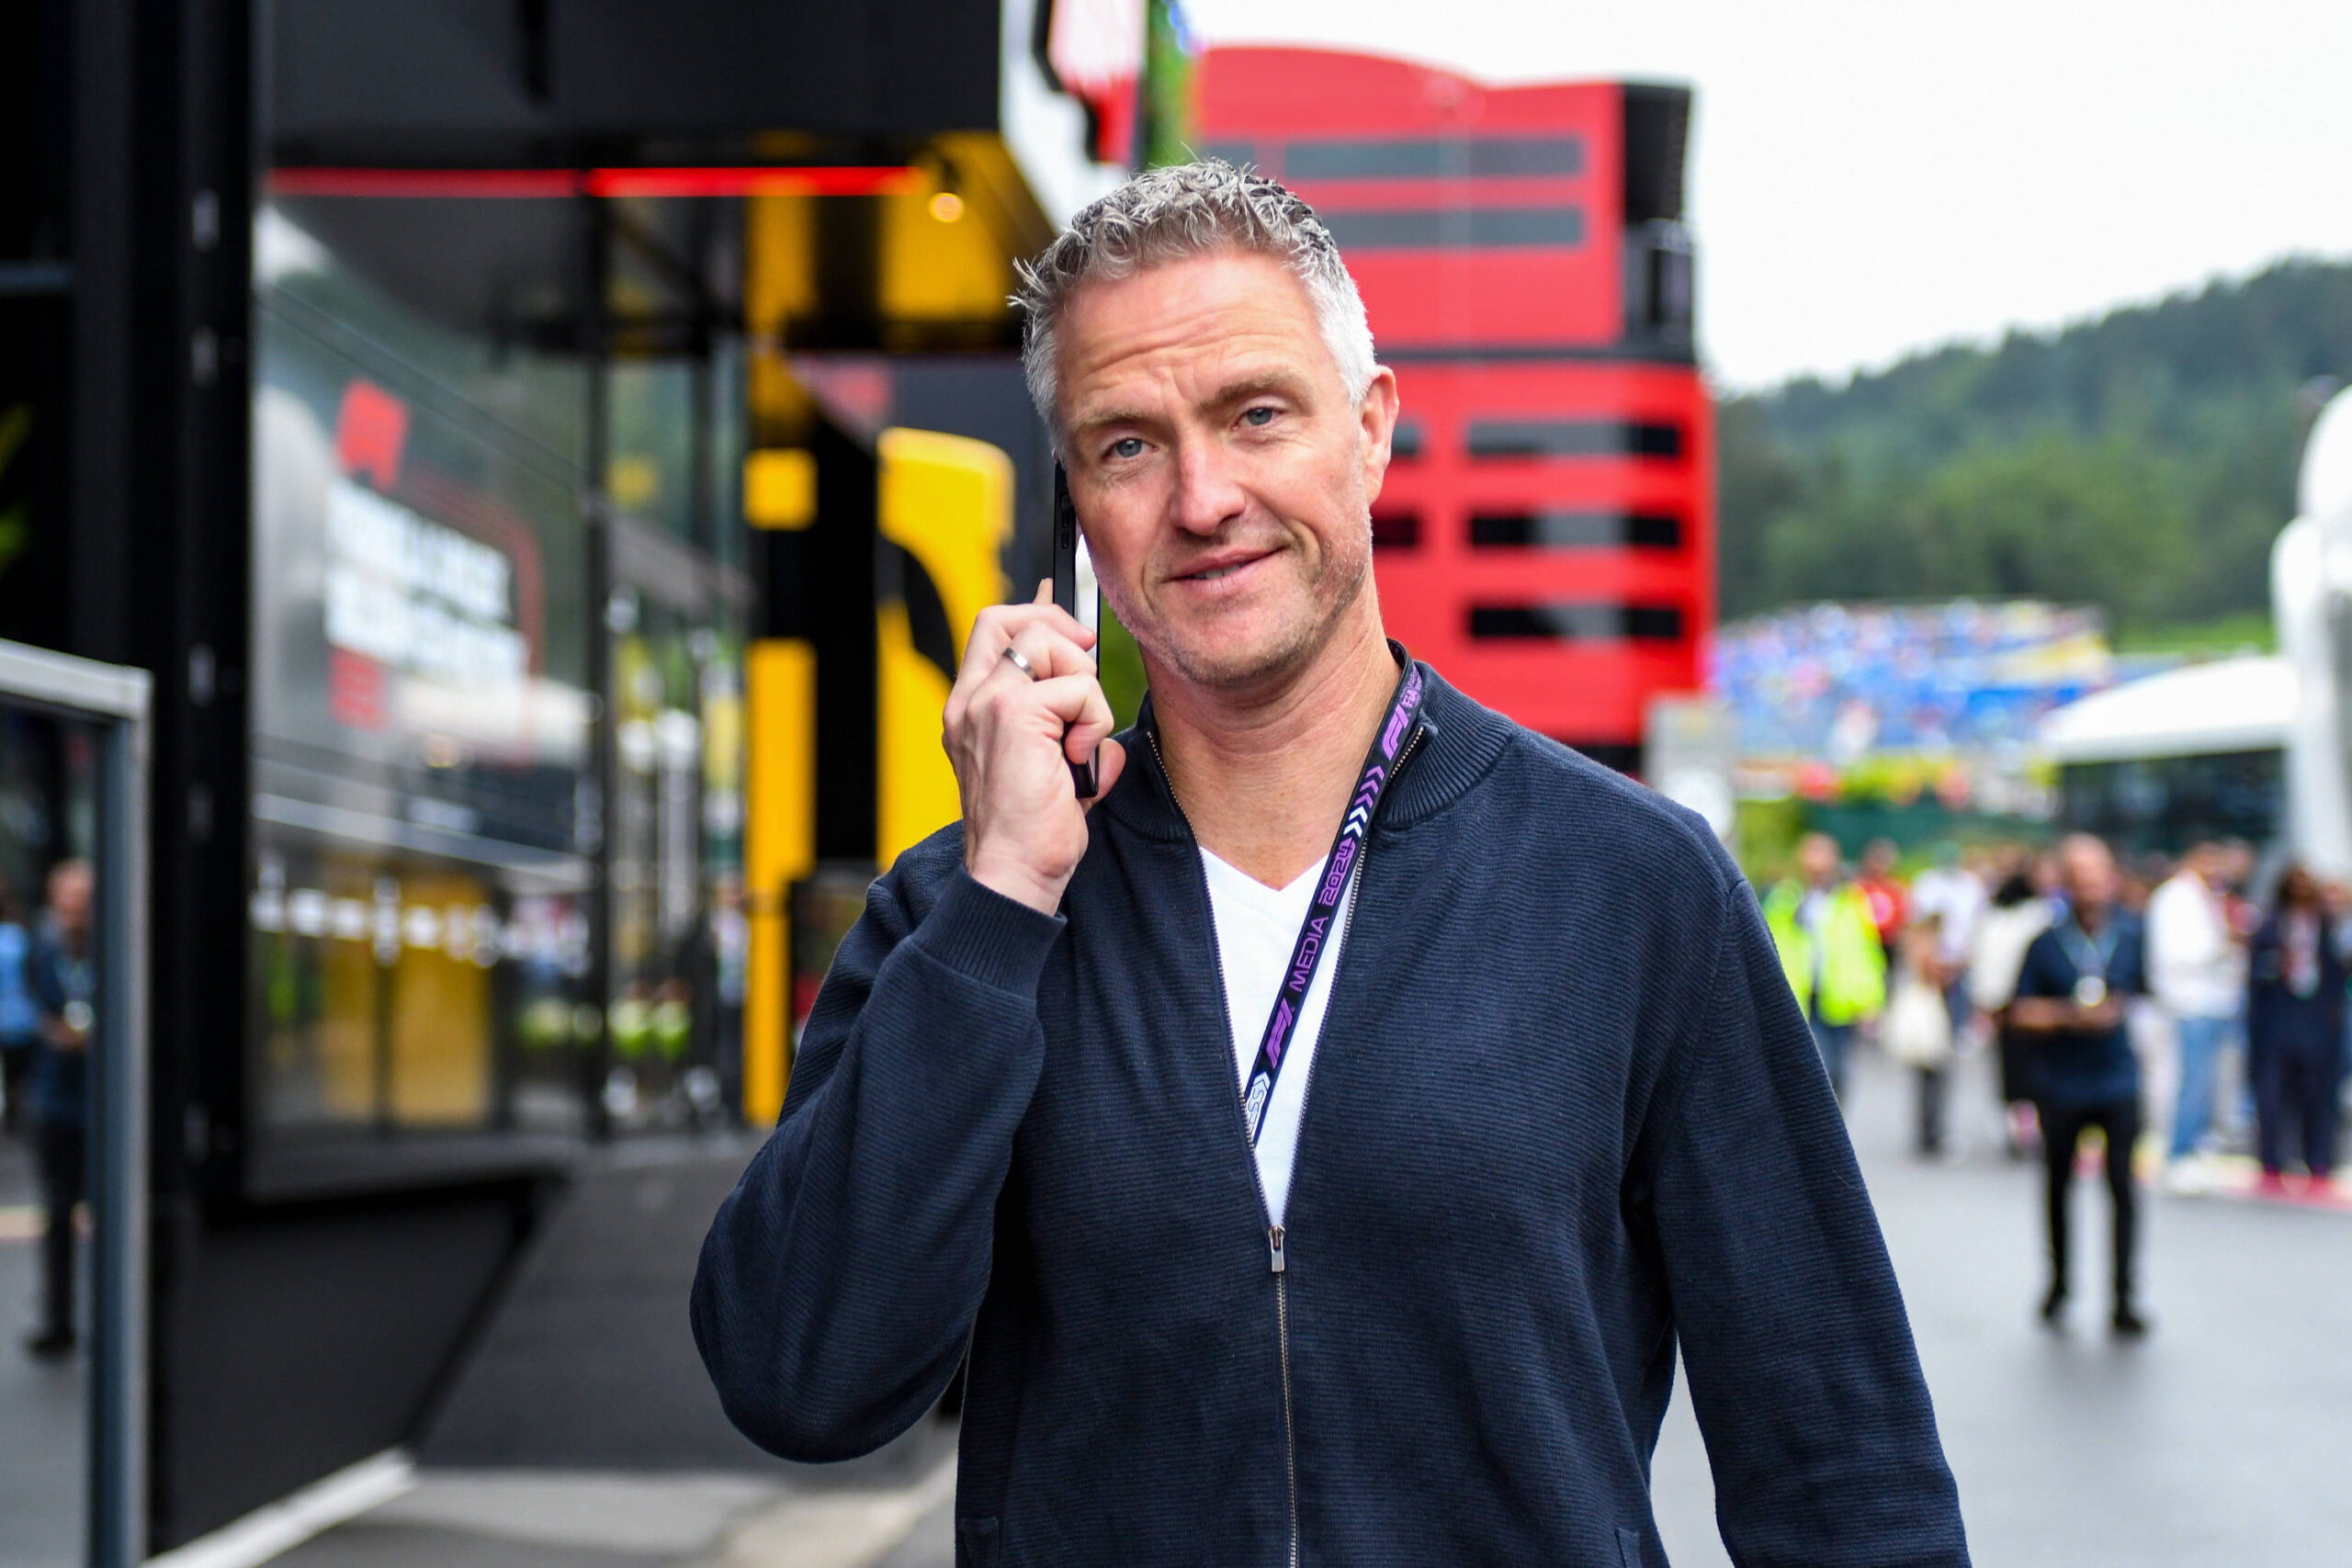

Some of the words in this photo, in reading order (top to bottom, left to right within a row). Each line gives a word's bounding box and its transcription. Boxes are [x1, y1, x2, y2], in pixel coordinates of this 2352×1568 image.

[1382, 704, 1408, 761] F1
[1288, 917, 1329, 992] MEDIA
[1319, 837, 1353, 905] 2024
[1266, 998, 1293, 1069] F1
